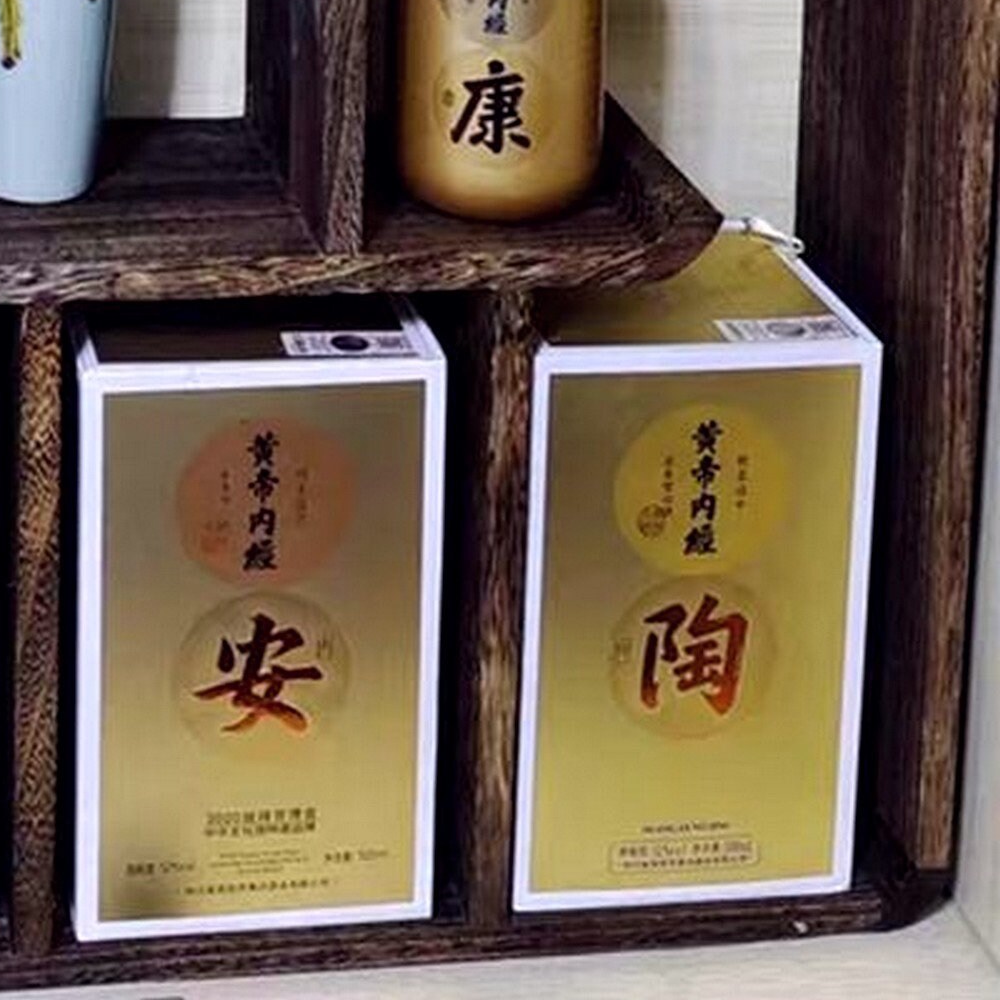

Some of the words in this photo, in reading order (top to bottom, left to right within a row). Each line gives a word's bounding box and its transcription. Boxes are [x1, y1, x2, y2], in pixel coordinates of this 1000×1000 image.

[450, 59, 532, 154] 康
[192, 611, 322, 733] 安
[640, 593, 748, 716] 陶
